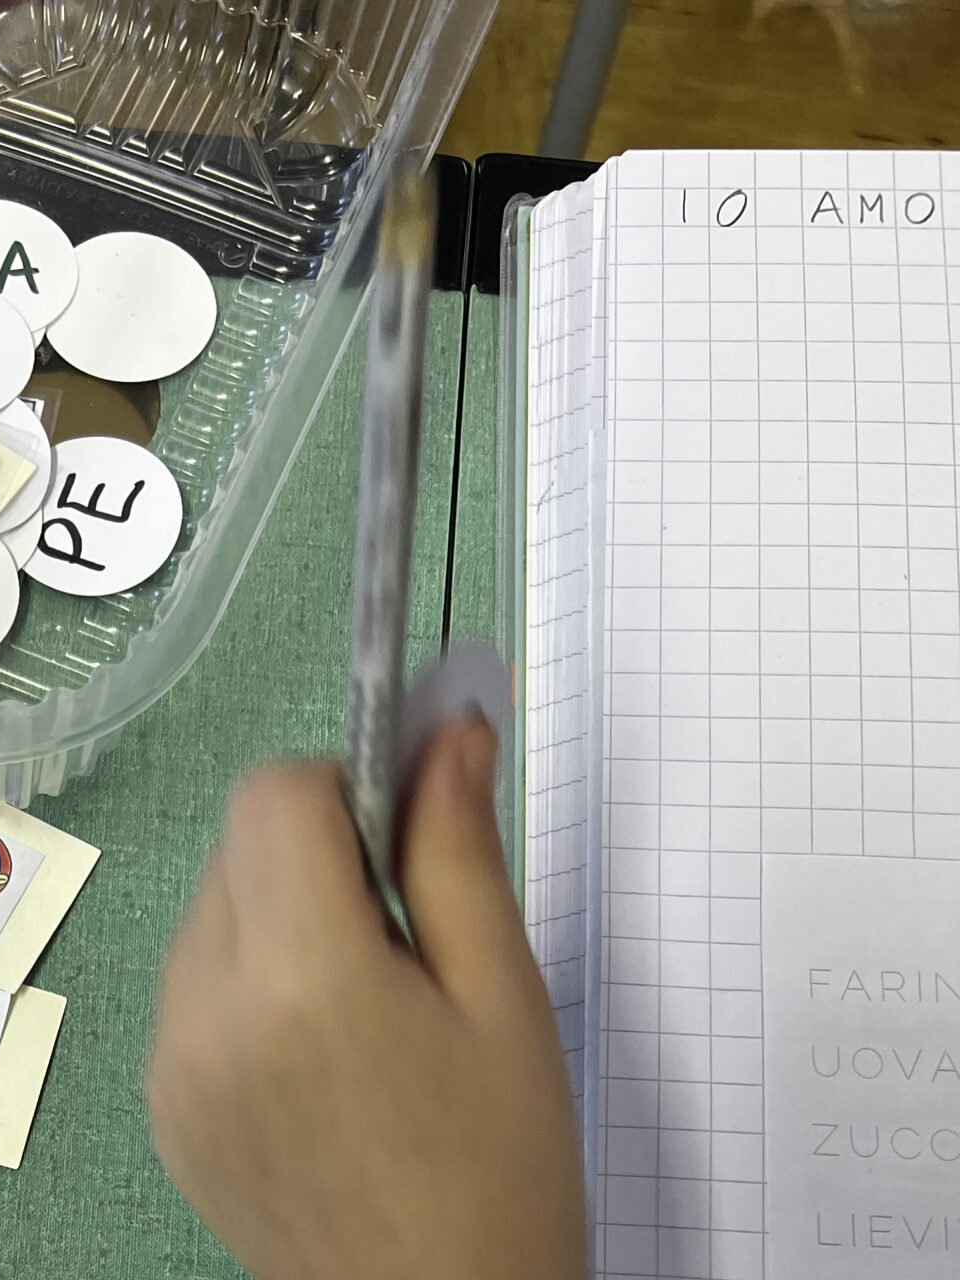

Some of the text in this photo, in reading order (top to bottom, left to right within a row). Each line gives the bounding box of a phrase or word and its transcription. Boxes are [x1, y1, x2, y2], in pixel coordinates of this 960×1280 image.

[809, 190, 936, 225] AMO
[37, 472, 145, 571] PE
[807, 967, 960, 1004] FARIN
[810, 1043, 960, 1082] UOVA
[811, 1122, 960, 1163] ZUCC
[815, 1210, 960, 1252] LIEVI
